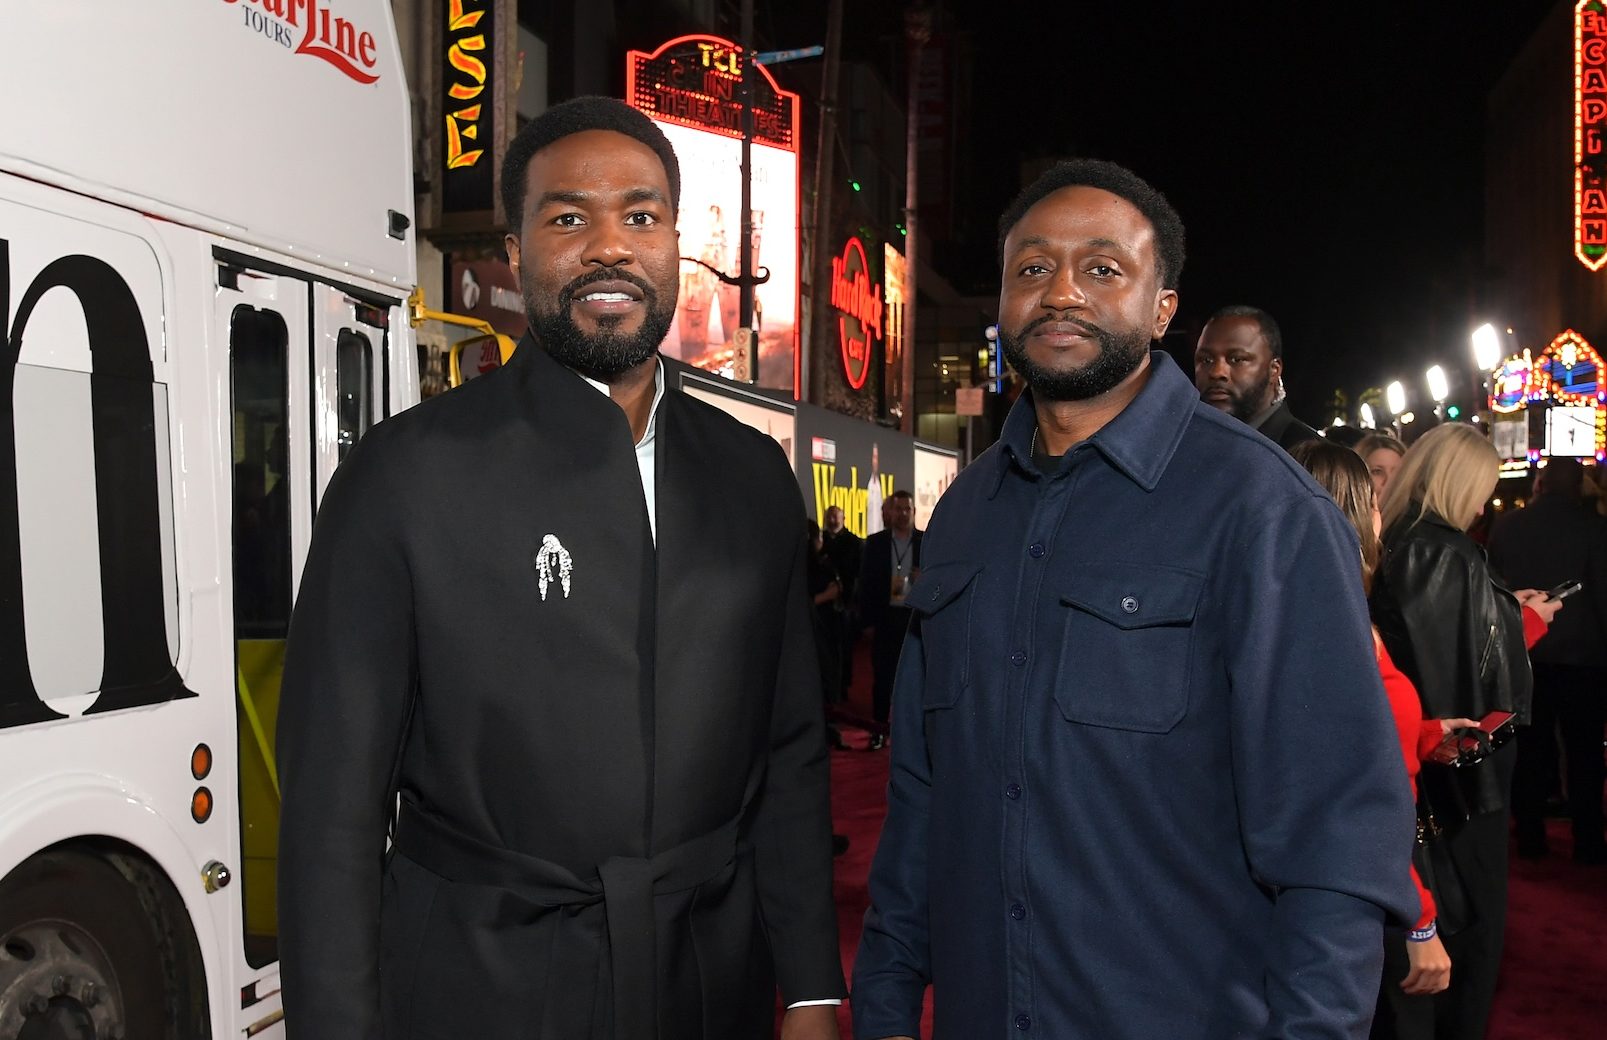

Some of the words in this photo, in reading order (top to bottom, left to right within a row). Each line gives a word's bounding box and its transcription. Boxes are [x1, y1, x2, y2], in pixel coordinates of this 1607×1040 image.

[242, 5, 292, 49] TOURS
[698, 43, 742, 75] TCL
[1582, 38, 1607, 244] CAPIAN
